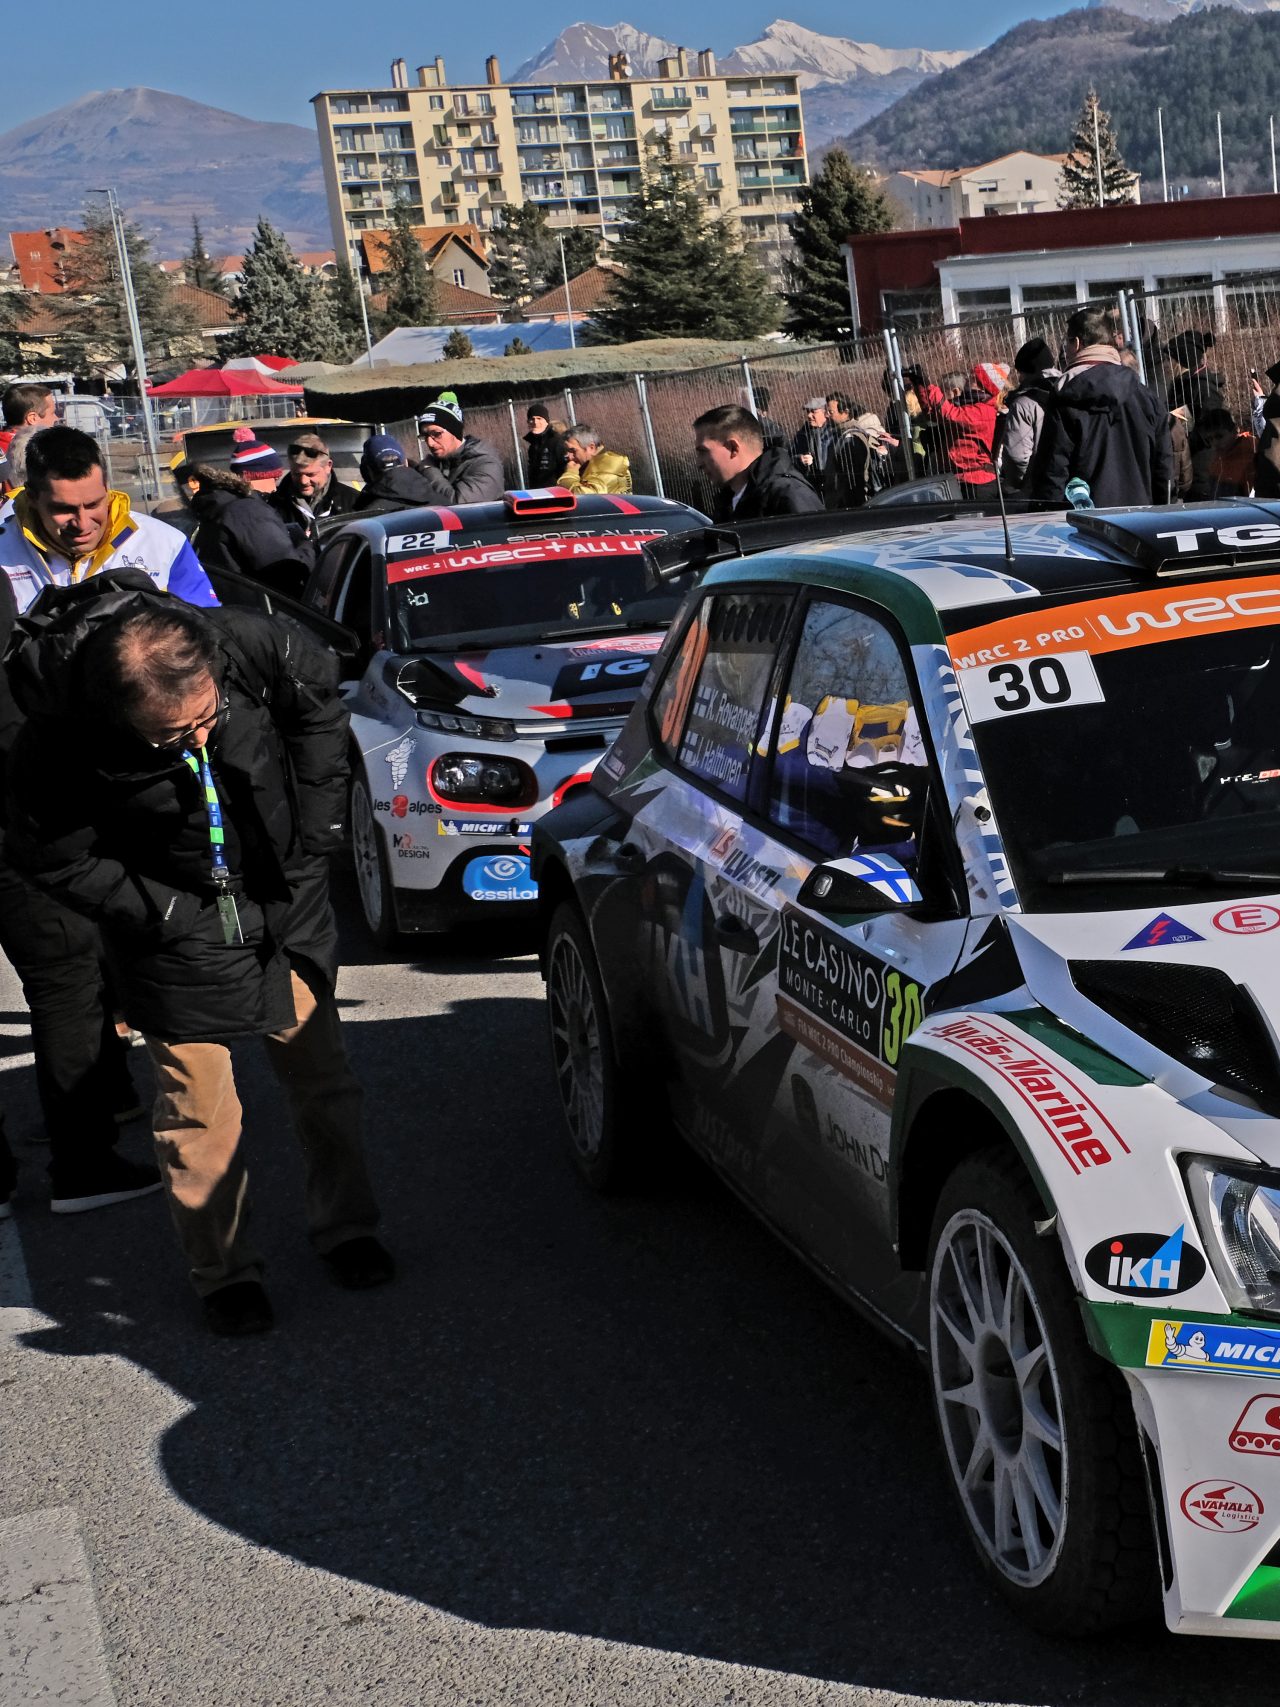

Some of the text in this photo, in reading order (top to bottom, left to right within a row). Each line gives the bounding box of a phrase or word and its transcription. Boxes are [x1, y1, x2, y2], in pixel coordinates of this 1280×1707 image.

[401, 532, 436, 550] 22
[403, 563, 431, 574] WRC
[572, 541, 617, 554] ALL
[954, 644, 1010, 669] WRC
[1013, 639, 1031, 652] 2
[1036, 626, 1085, 647] PRO
[988, 657, 1071, 711] 30
[701, 740, 743, 787] Halttunen
[374, 798, 391, 811] les
[409, 801, 443, 815] alpes
[398, 850, 430, 859] DESIGN
[1231, 908, 1267, 929] E
[783, 911, 881, 1010] LE CASINO
[884, 972, 922, 1065] 30
[840, 1048, 884, 1094] Championship
[827, 1112, 870, 1173] JOHN
[1222, 1511, 1260, 1521] Logistics
